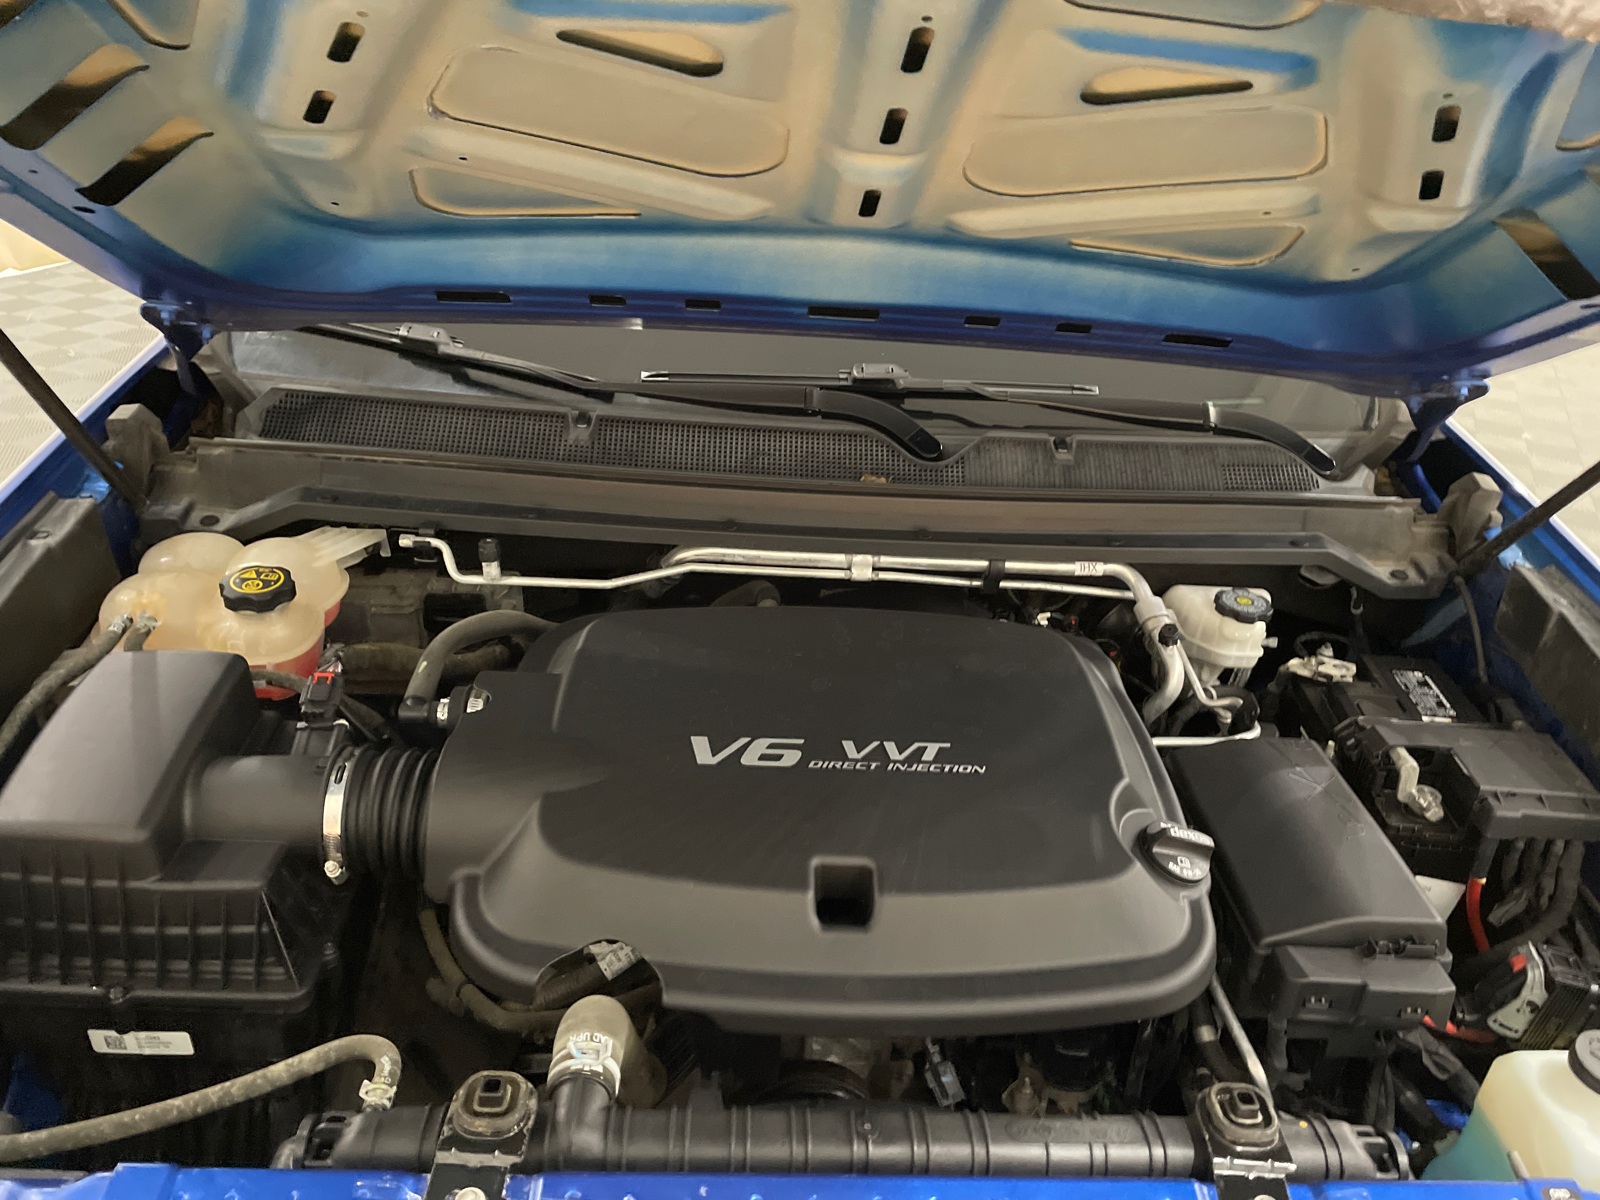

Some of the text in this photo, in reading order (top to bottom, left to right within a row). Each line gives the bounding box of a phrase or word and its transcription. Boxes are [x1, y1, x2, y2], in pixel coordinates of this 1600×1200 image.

[690, 735, 805, 767] V6
[841, 739, 951, 760] VVT
[808, 759, 987, 775] DIRECT INJECTION
